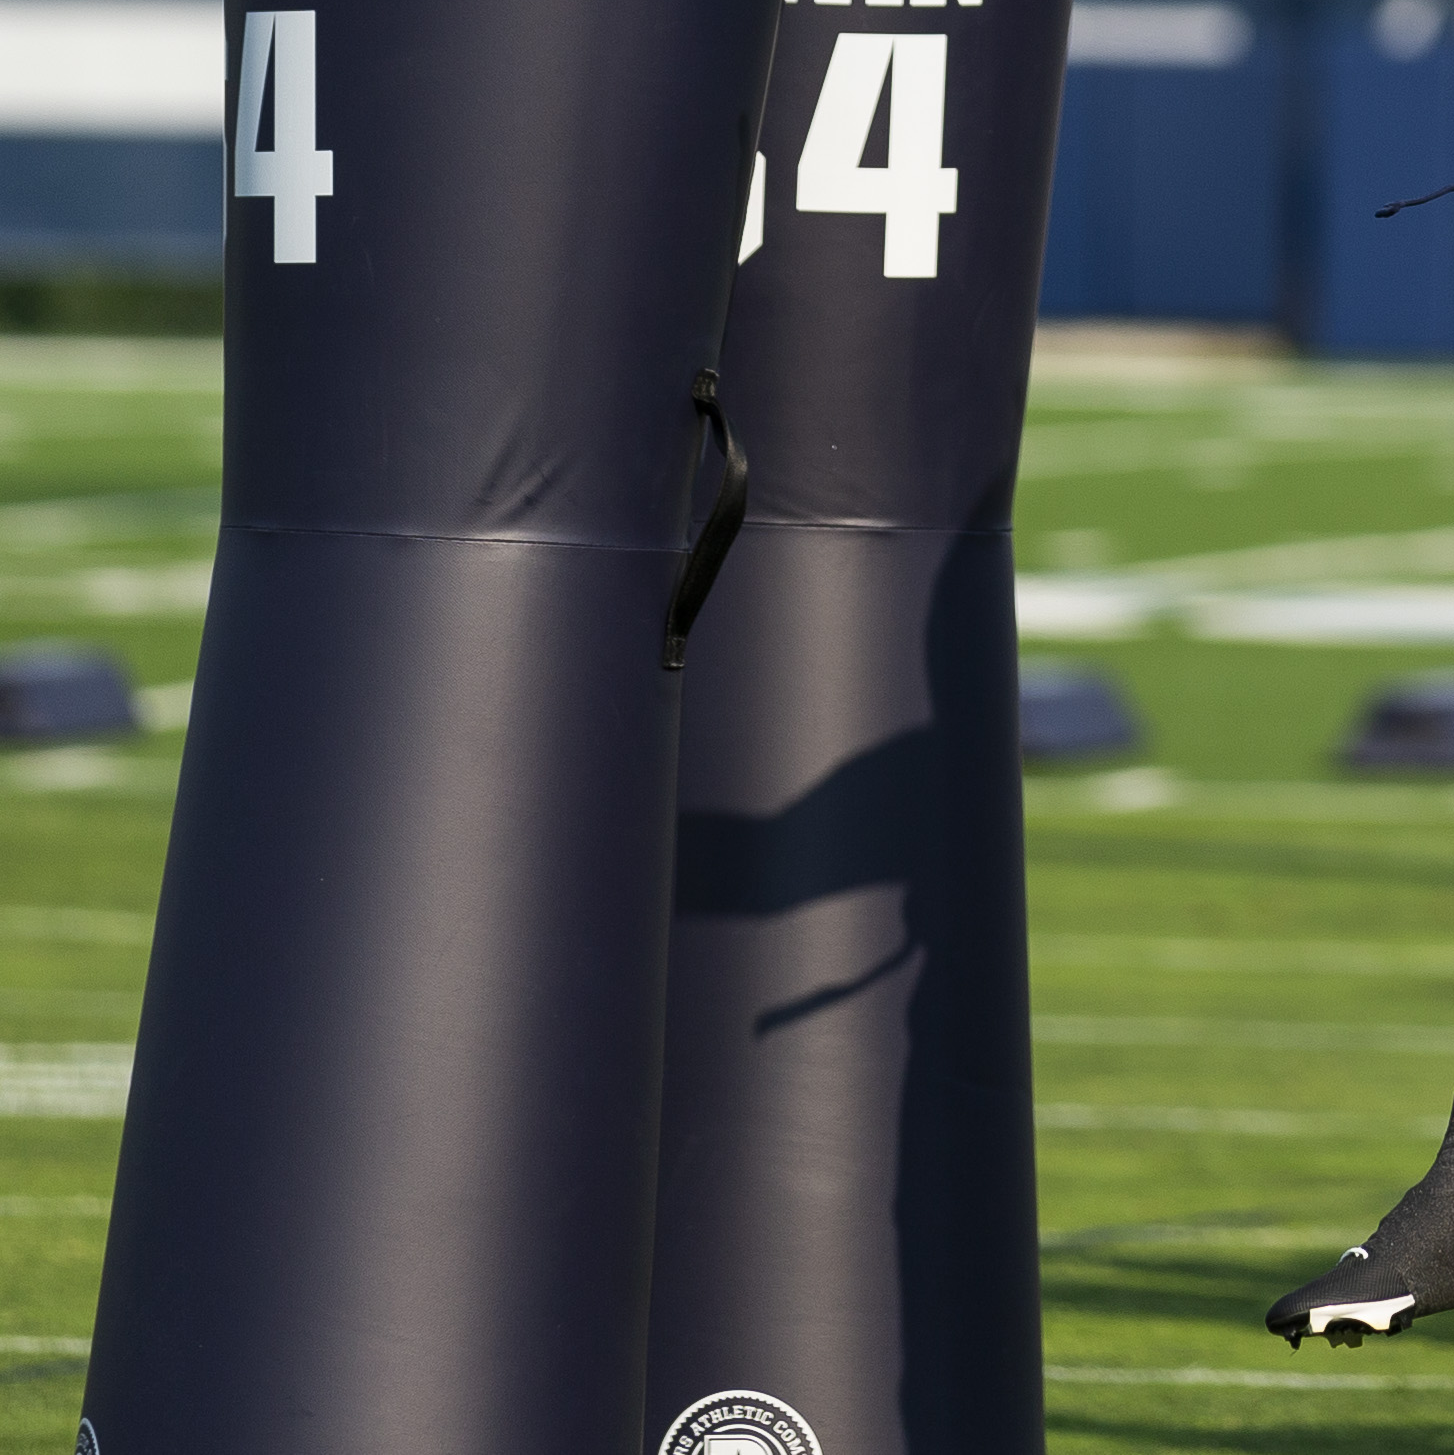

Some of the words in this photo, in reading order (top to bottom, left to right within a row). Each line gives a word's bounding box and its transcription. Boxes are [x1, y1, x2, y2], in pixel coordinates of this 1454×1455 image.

[234, 9, 333, 263] 4
[738, 32, 958, 278] 4
[689, 1404, 775, 1437] ATHLETIC
